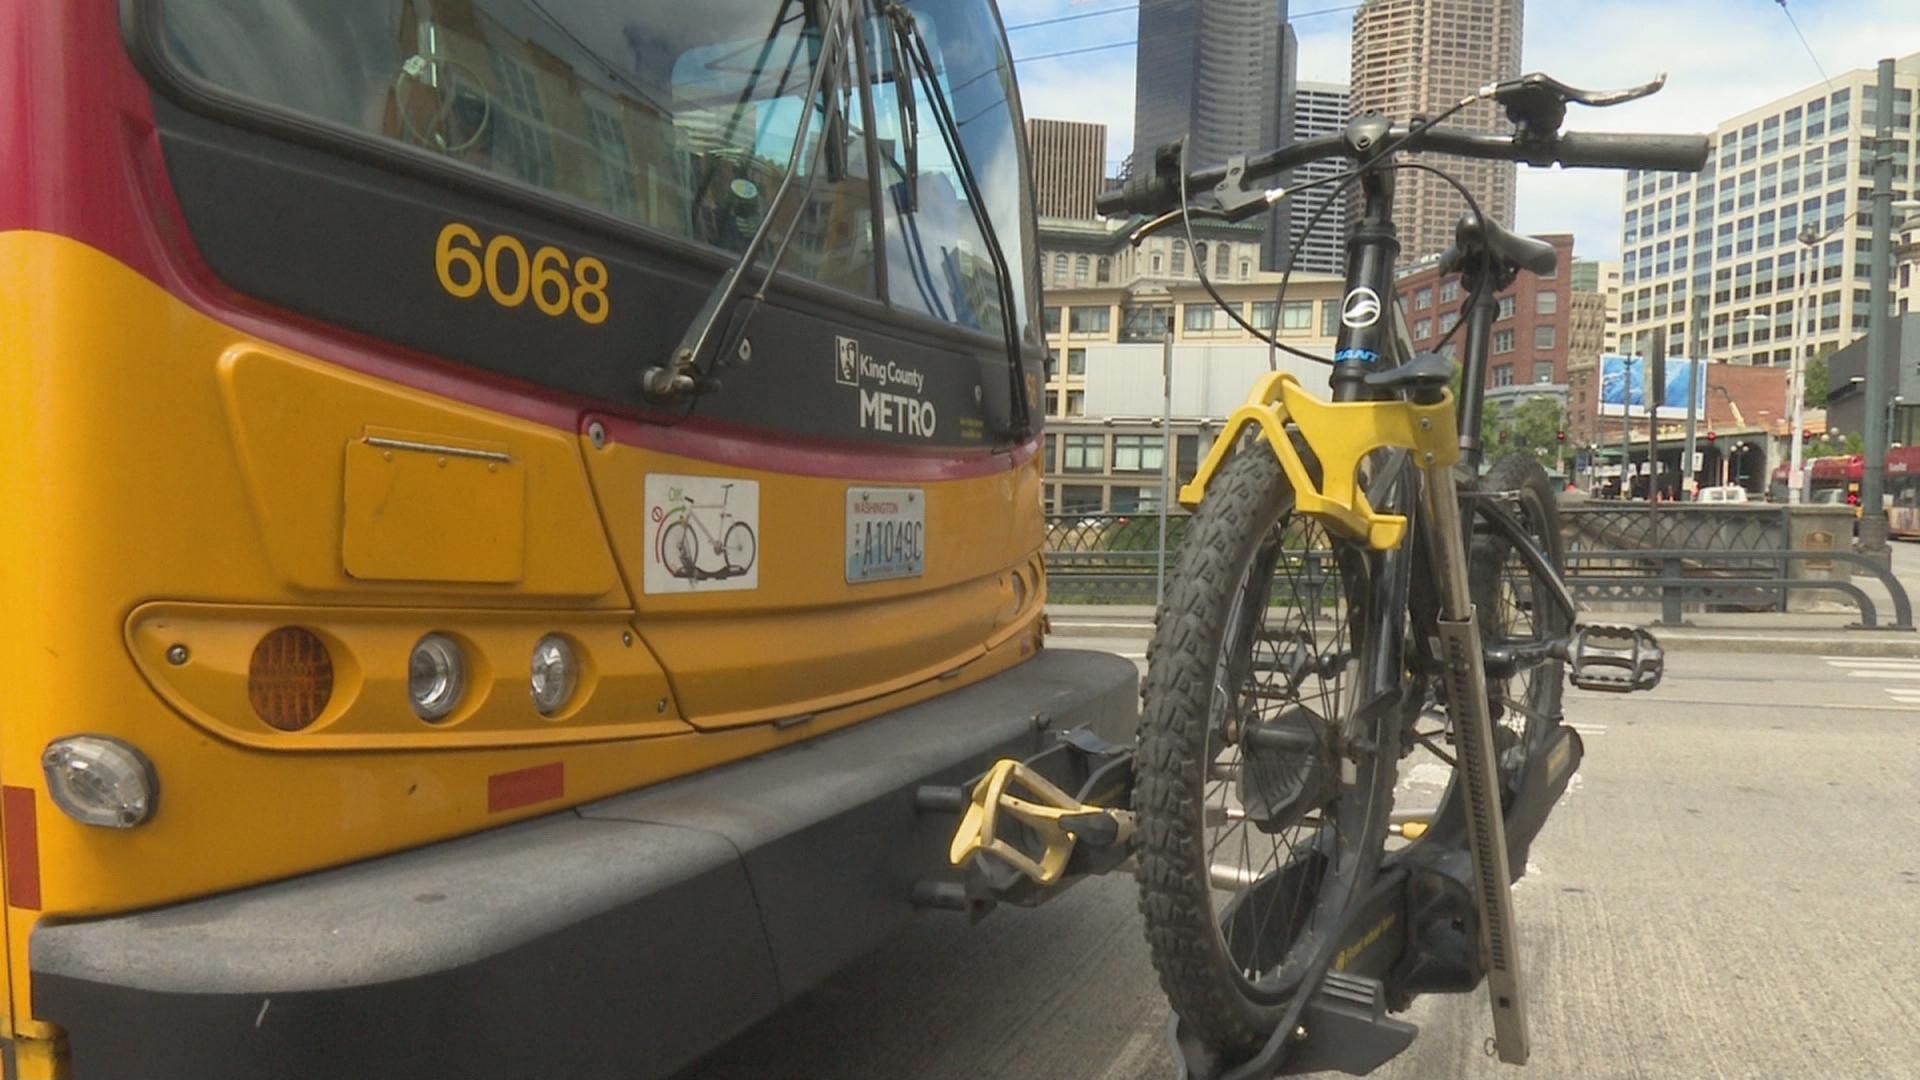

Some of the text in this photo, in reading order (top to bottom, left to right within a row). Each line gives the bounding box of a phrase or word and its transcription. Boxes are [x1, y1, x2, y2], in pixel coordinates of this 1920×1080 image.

[435, 222, 610, 325] 6068
[860, 353, 924, 394] King County
[860, 388, 936, 437] METRO
[864, 520, 922, 565] A1049C
